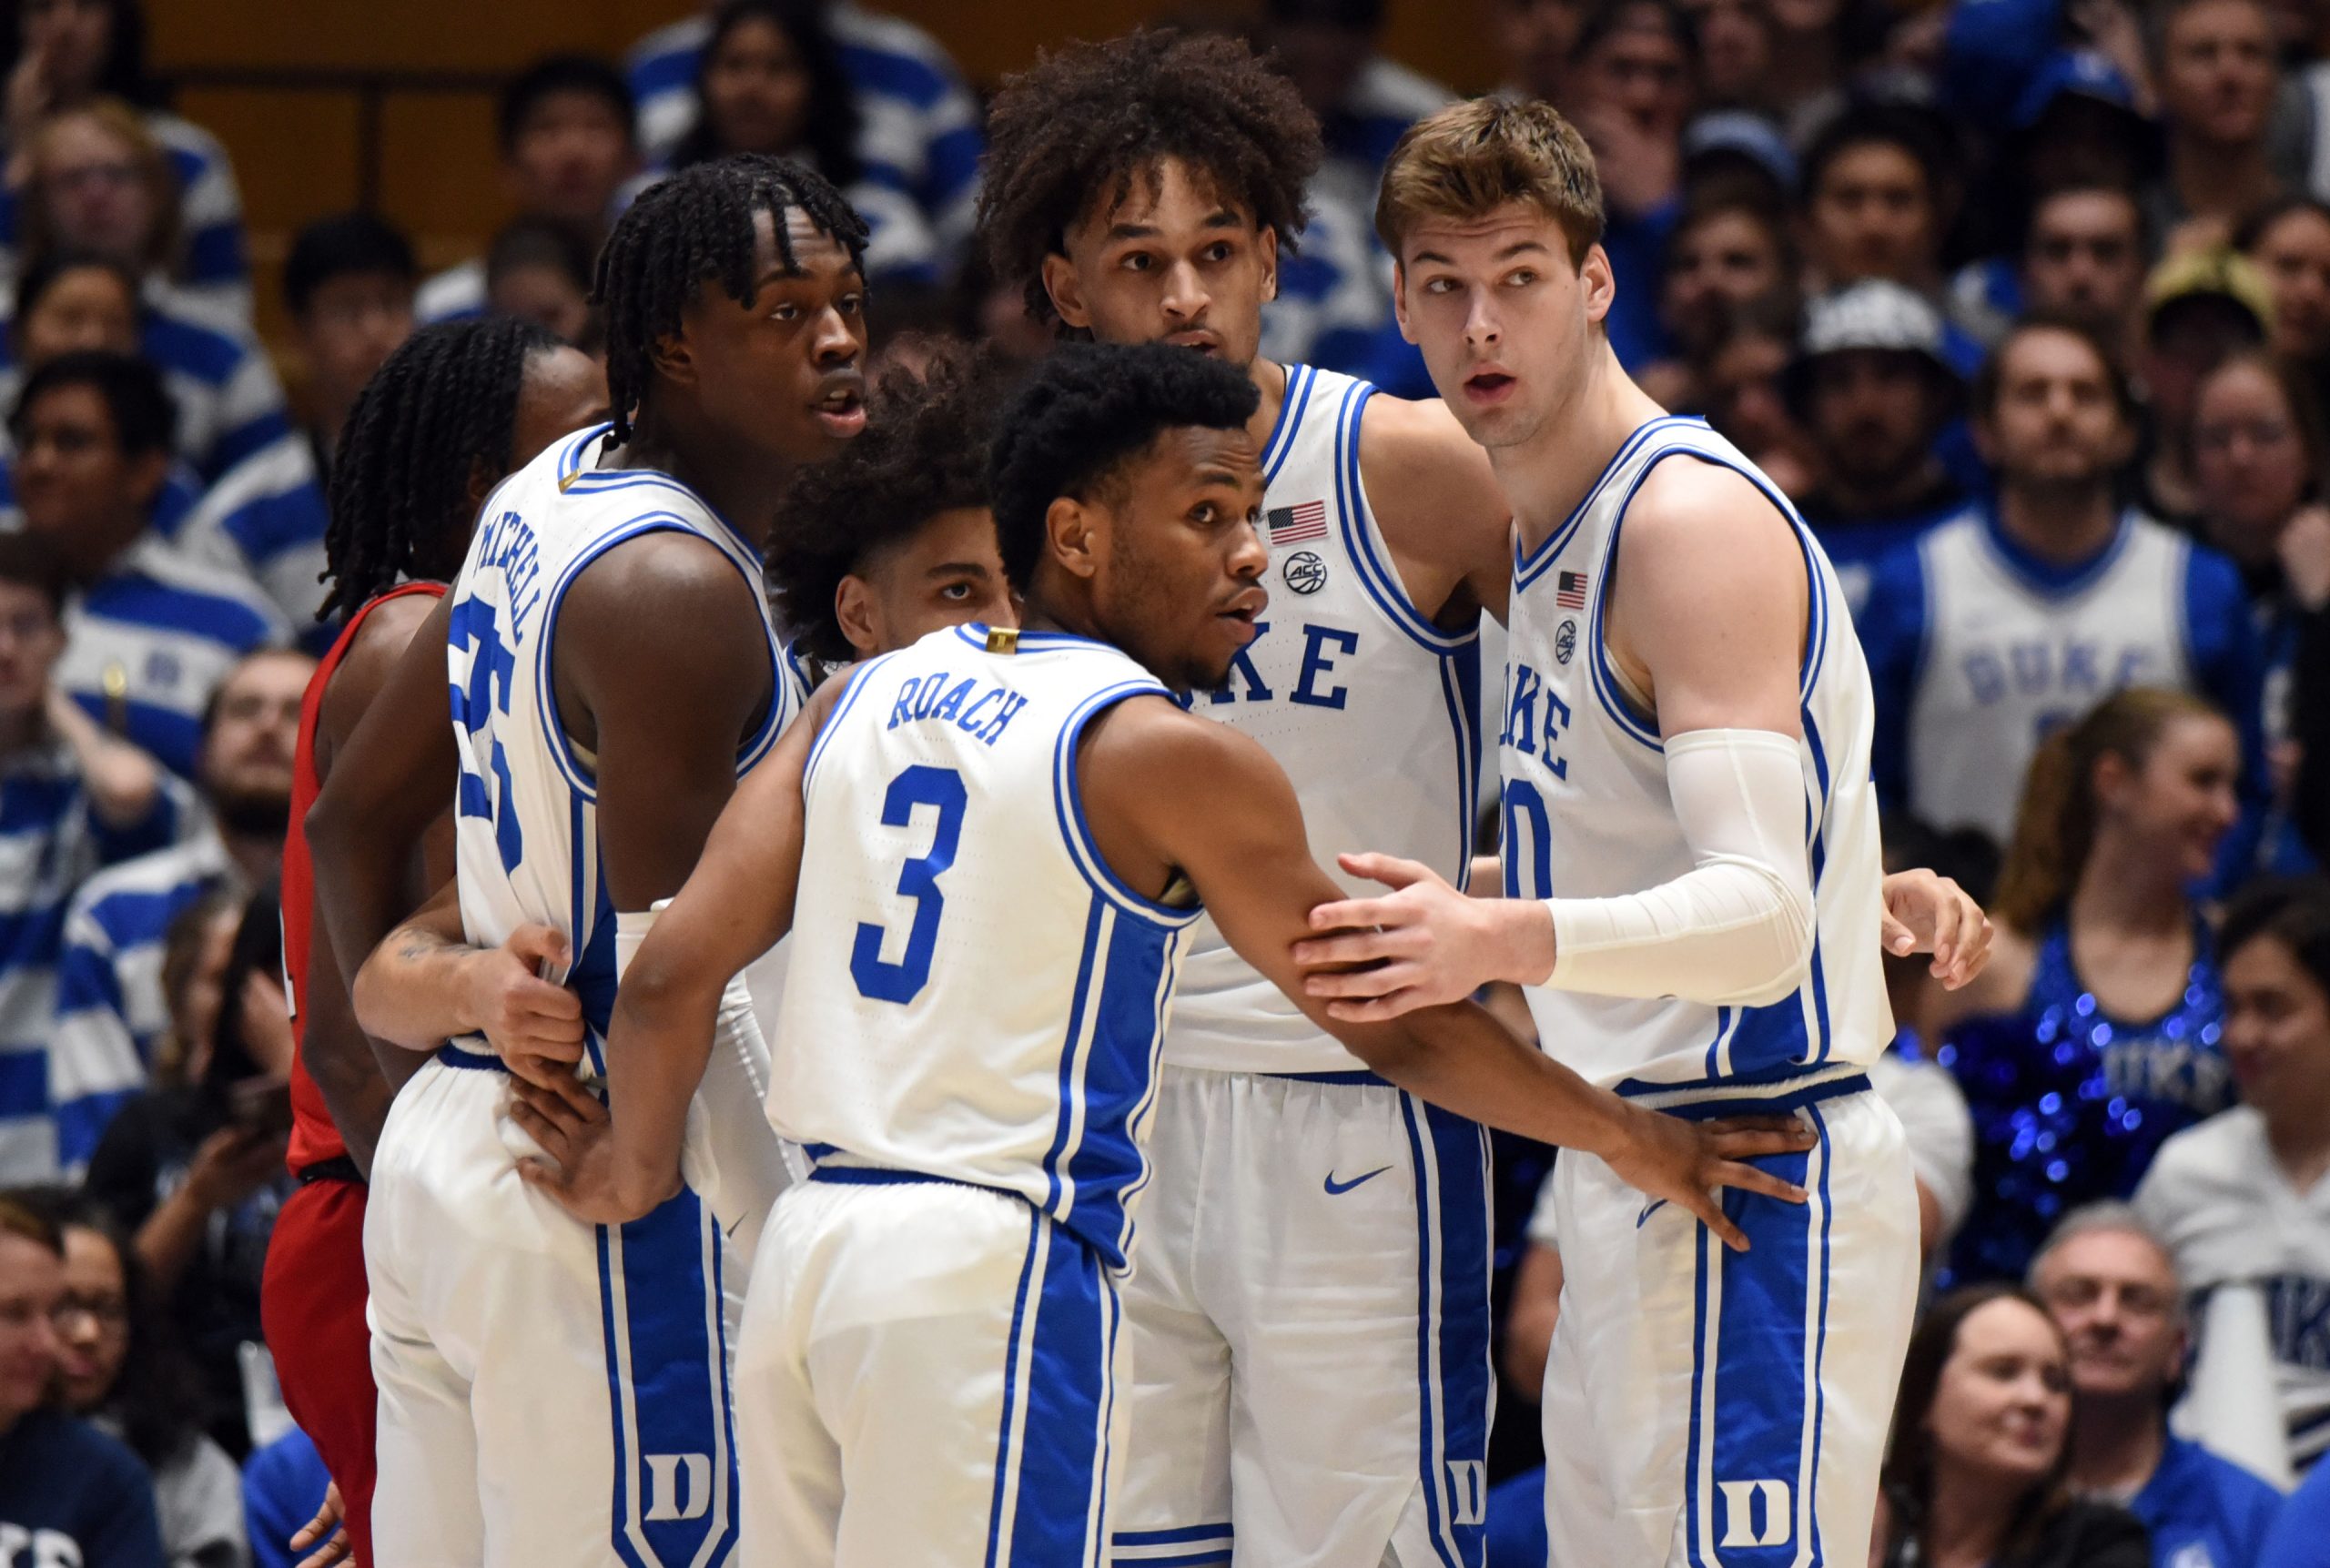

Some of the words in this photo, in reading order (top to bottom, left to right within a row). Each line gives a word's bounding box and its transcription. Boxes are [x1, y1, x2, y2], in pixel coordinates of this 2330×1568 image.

[1290, 562, 1324, 577] ACC
[1180, 622, 1359, 711] KE
[887, 672, 1028, 746] ROACH
[1500, 662, 1571, 782] KE
[1500, 774, 1553, 899] 0
[849, 764, 967, 1006] 3
[644, 1452, 711, 1521] D
[1445, 1460, 1486, 1525] D
[1717, 1479, 1790, 1547] D
